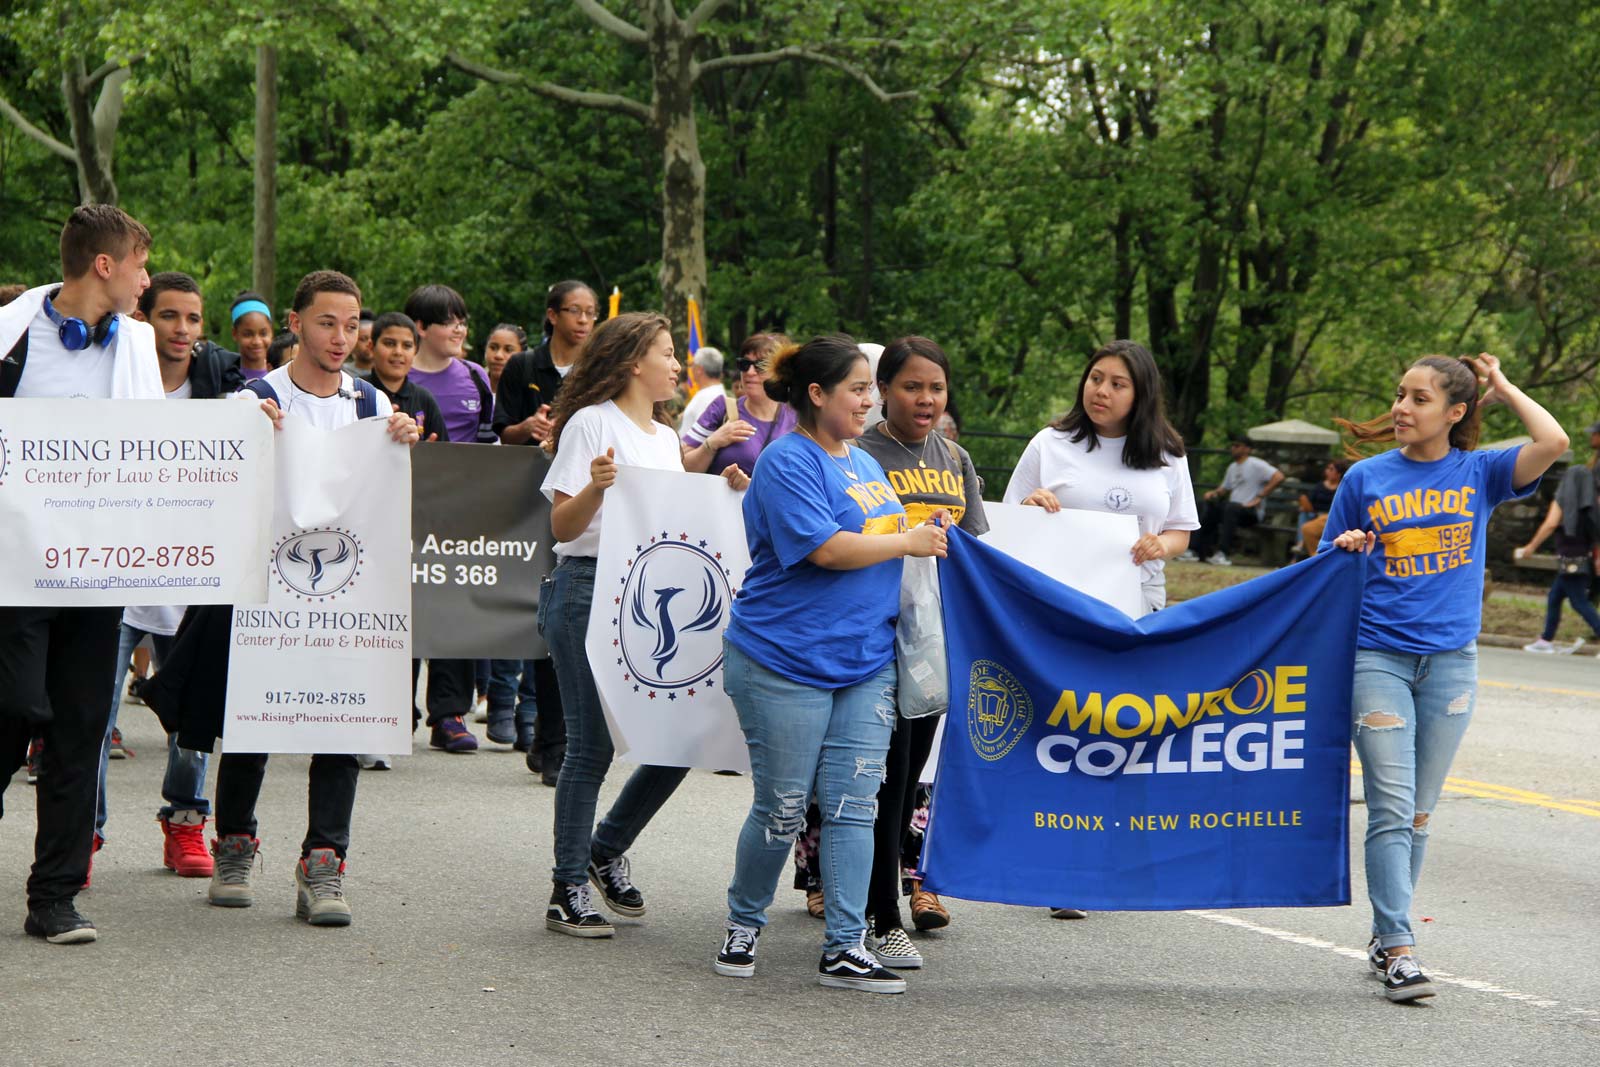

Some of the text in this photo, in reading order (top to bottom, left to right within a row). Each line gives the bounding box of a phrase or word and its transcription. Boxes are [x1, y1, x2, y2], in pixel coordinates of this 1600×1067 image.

[21, 439, 245, 461] RISING PHOENIX
[25, 467, 239, 488] Center for Law & Politics
[888, 468, 966, 504] ONRO
[44, 497, 215, 510] Promoting Diversity & Democracy
[1367, 486, 1476, 531] MONROE
[421, 534, 537, 562] Academy
[1437, 525, 1471, 549] 1933
[45, 545, 215, 569] 917-702-8785
[1385, 546, 1473, 578] COLLEGE
[34, 576, 221, 589] www.RisingPhoenixCenter.org
[454, 565, 498, 585] 368
[236, 610, 408, 632] RISING PHOENIX
[236, 633, 404, 650] Center for Law & Politics
[265, 691, 366, 705] 917-702-8785
[1046, 665, 1308, 738] MONROE
[236, 712, 399, 726] www.RisingPhoenixCenter.org
[1036, 720, 1306, 777] COLLEGE
[1034, 810, 1303, 831] BRONX NEW ROCHELLE
